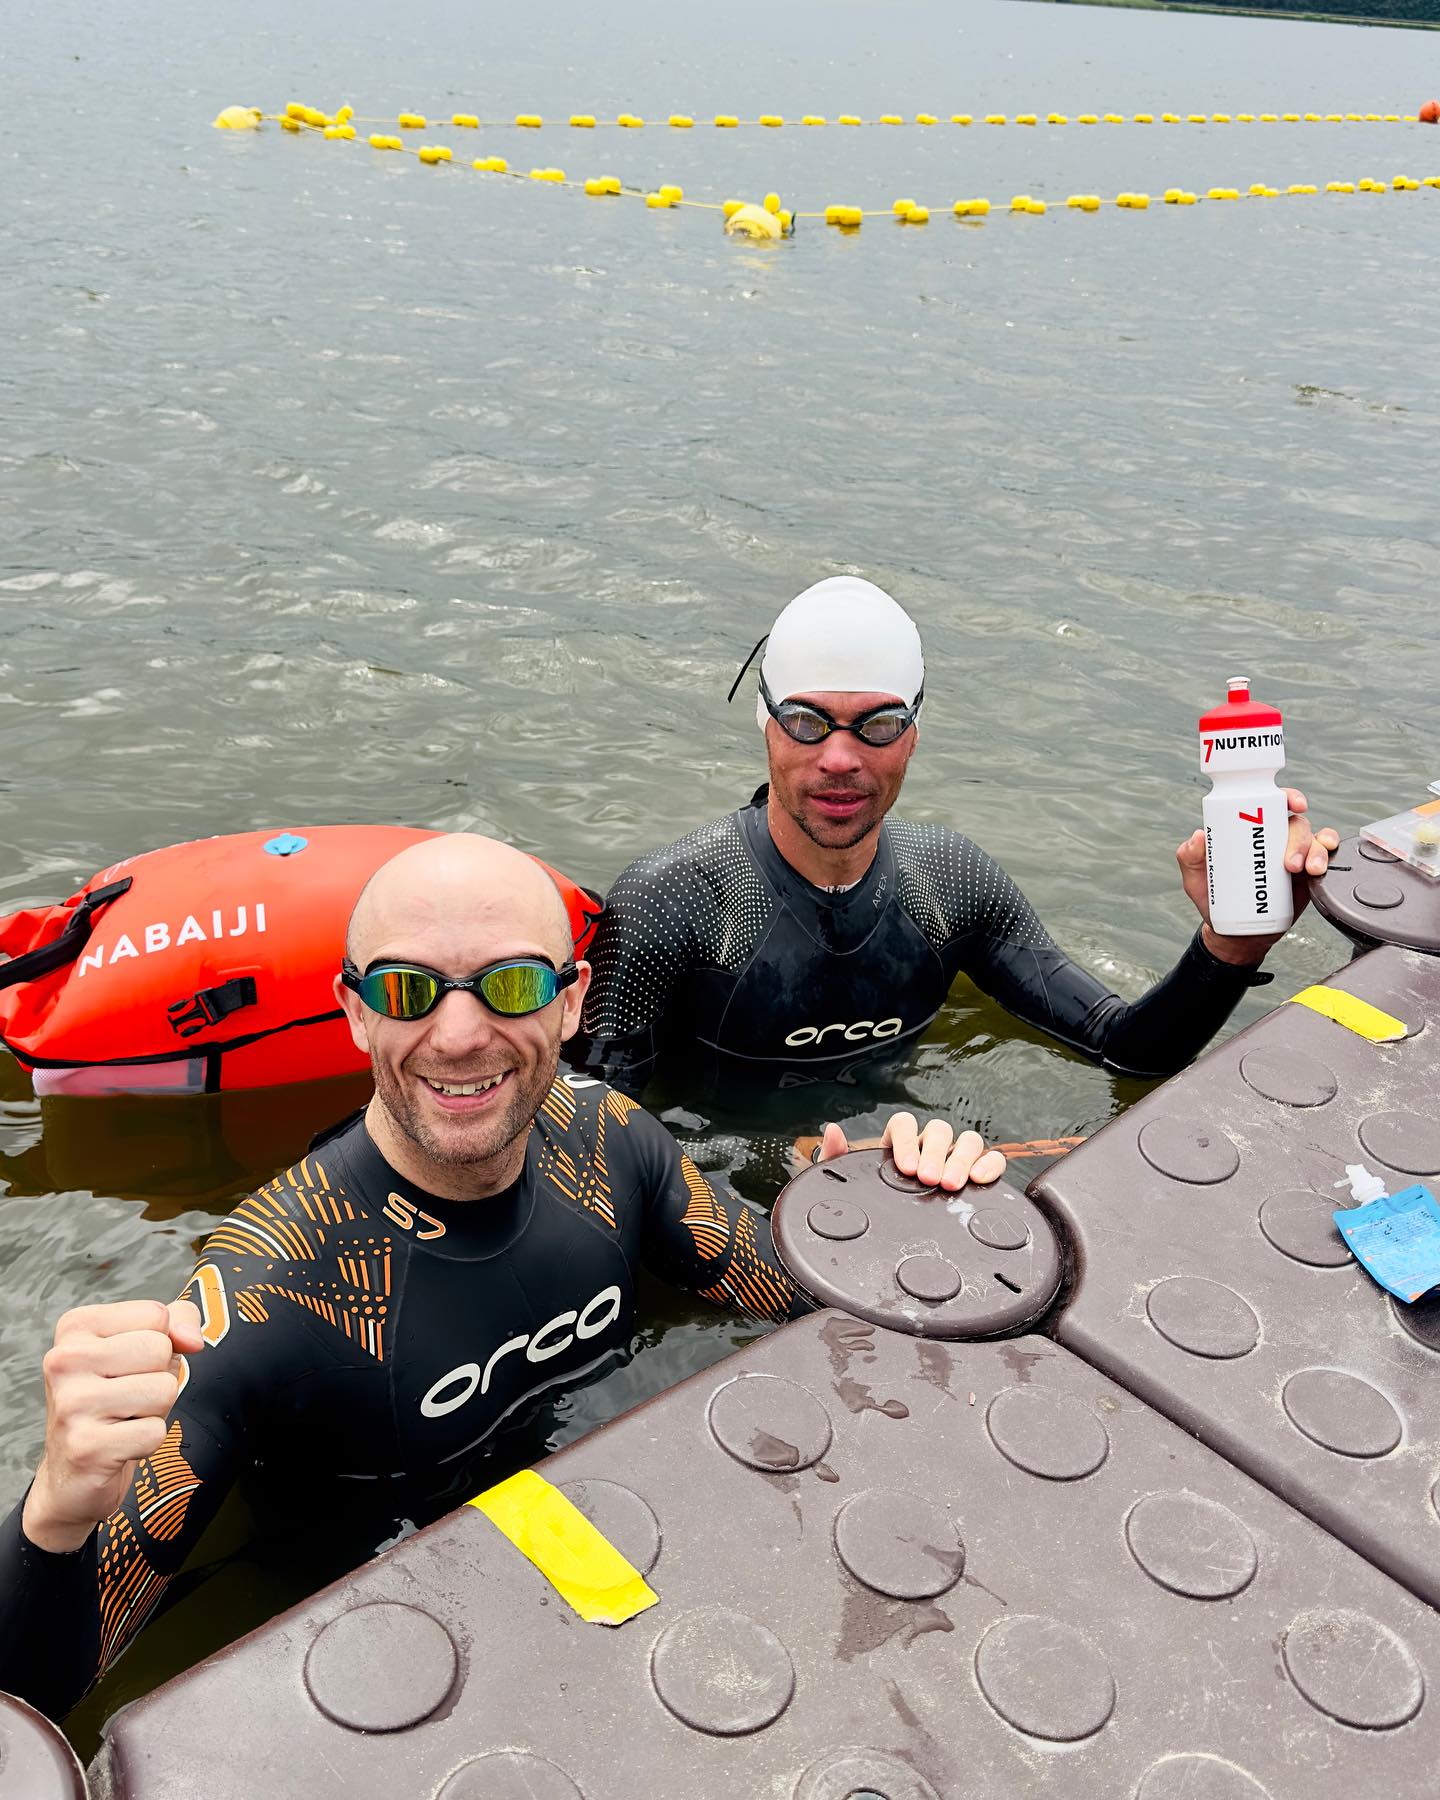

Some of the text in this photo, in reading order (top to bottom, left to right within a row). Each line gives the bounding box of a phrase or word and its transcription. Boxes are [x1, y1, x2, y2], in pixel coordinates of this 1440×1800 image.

[872, 872, 888, 909] APEX
[78, 903, 267, 977] NABAIJI
[785, 1017, 903, 1047] orca
[420, 1285, 621, 1418] orca
